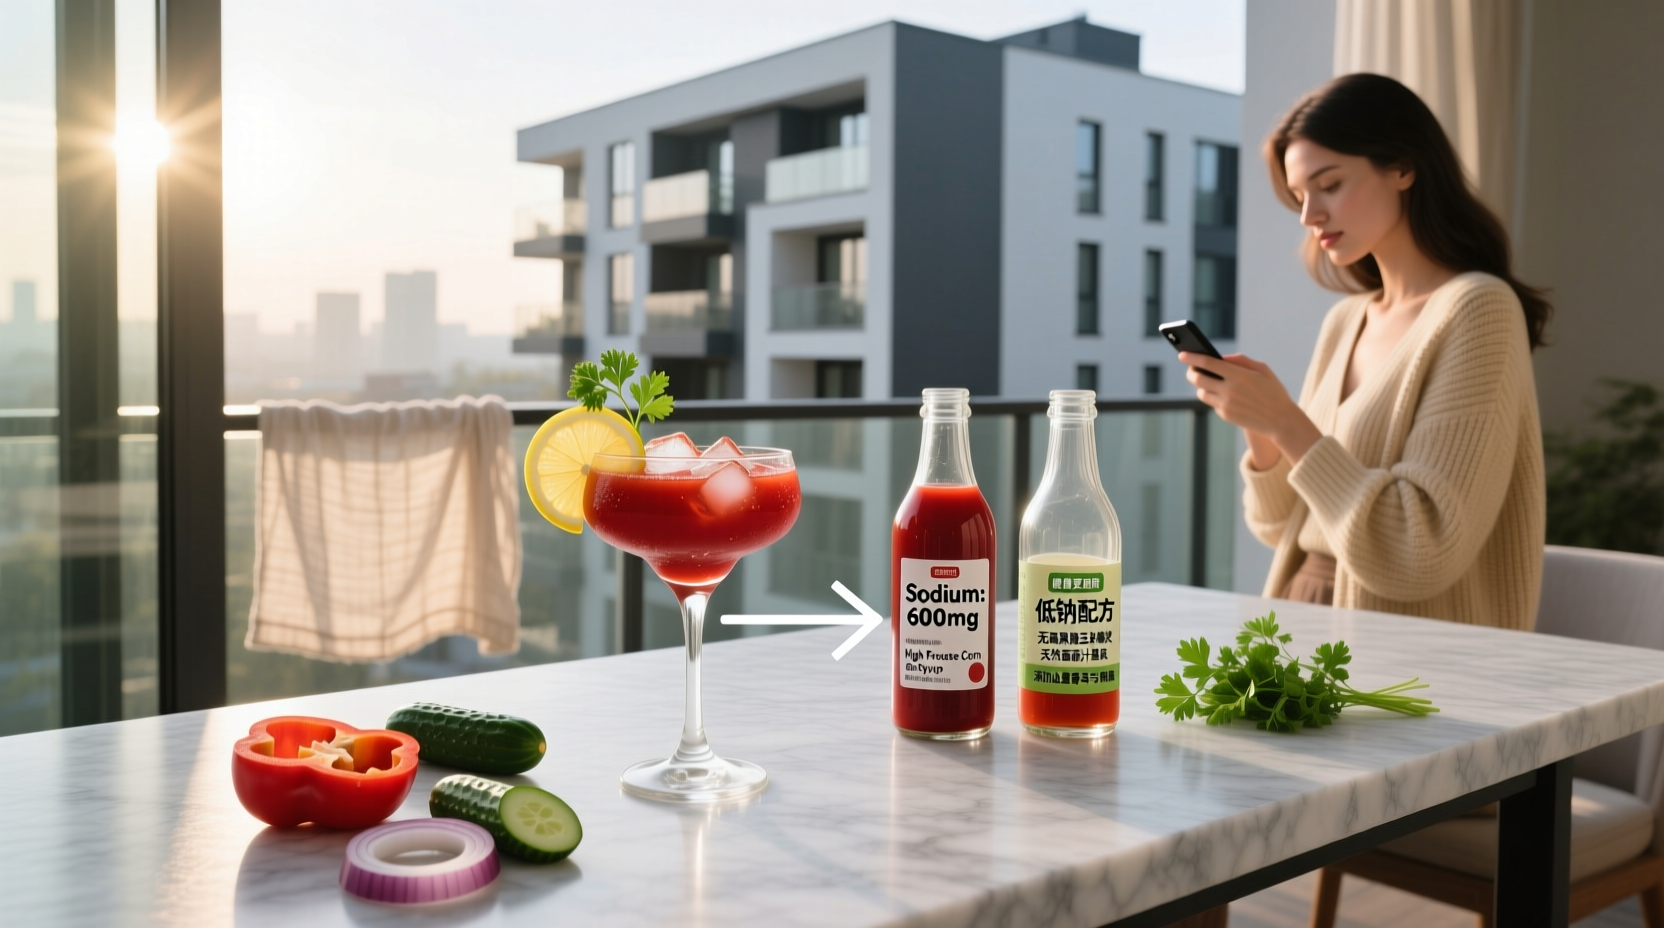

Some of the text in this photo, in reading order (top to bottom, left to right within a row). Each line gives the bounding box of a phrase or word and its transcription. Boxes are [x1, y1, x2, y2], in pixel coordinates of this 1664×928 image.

[905, 583, 985, 603] Sodium:
[907, 607, 979, 631] 600mg
[1035, 598, 1115, 624] 低钠配方
